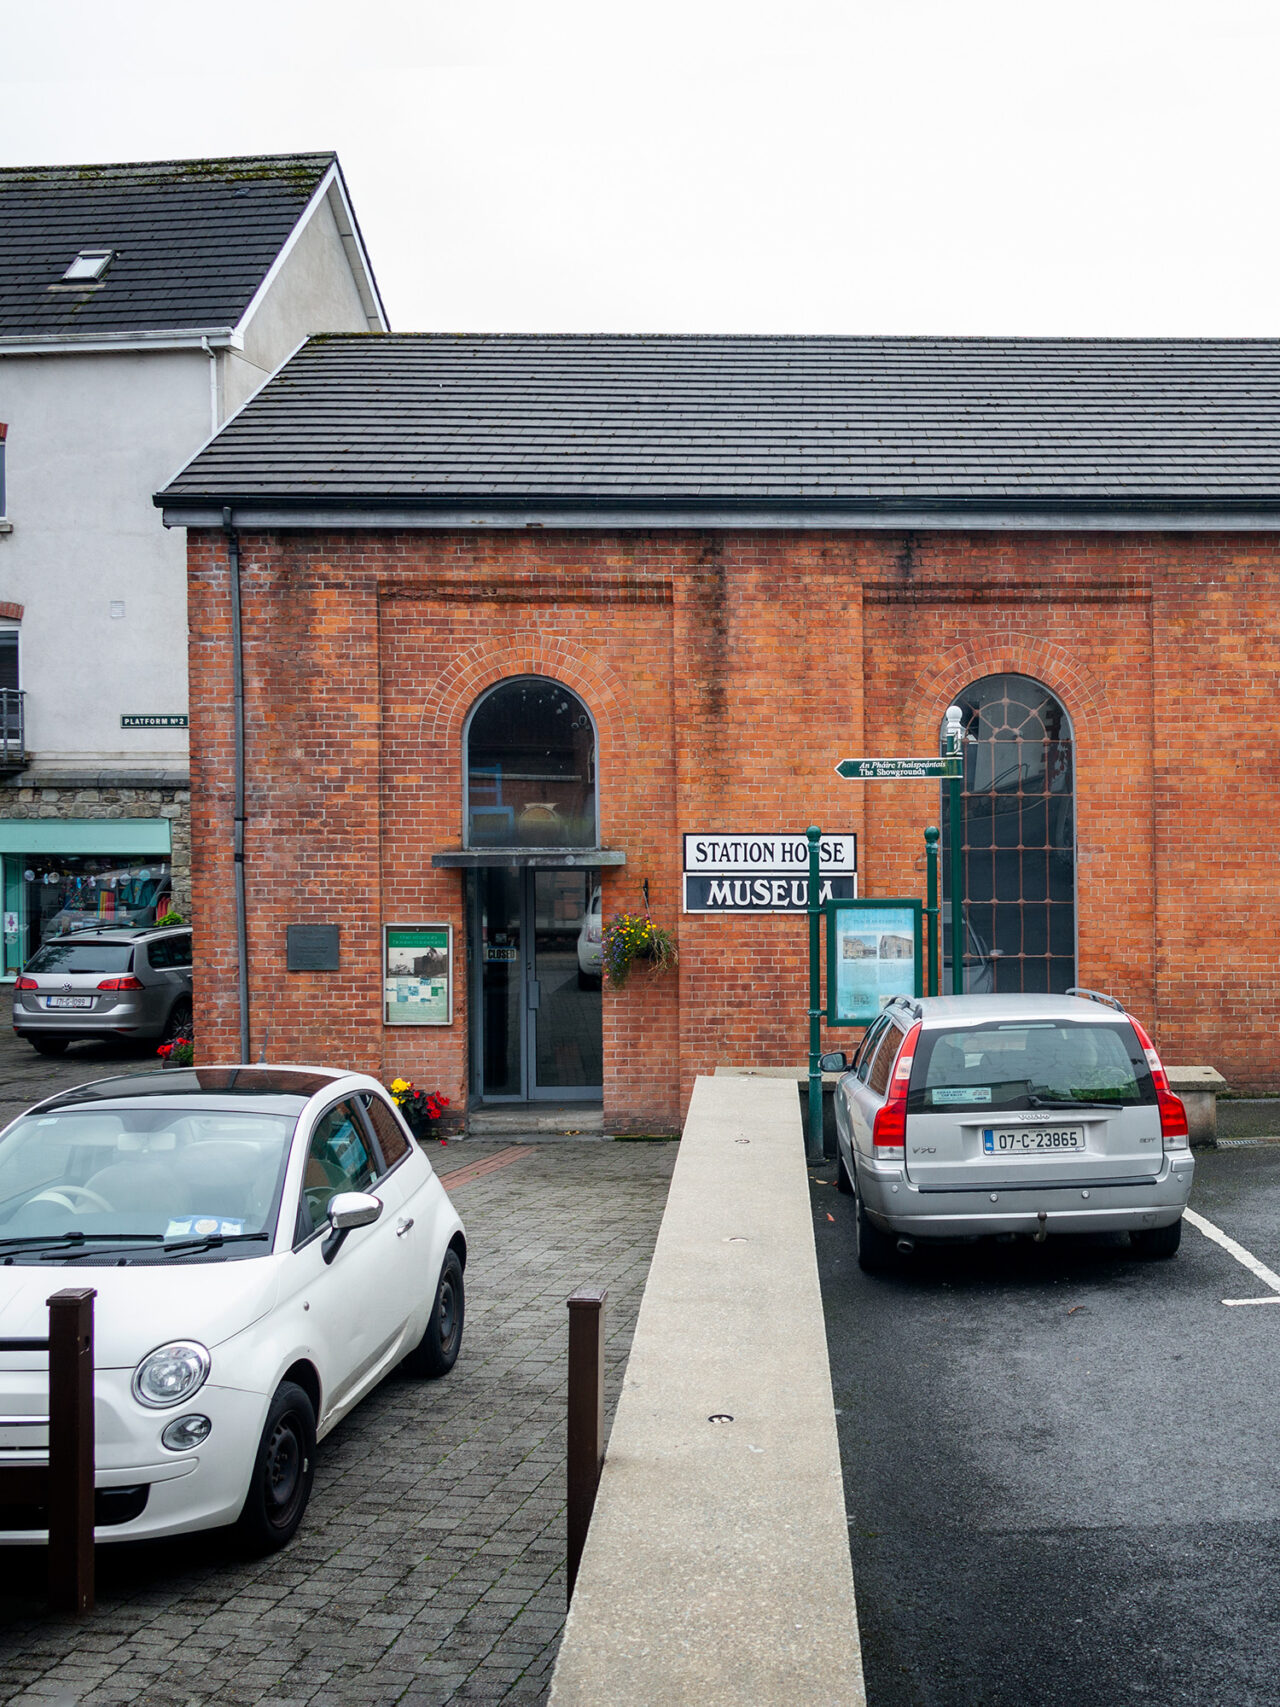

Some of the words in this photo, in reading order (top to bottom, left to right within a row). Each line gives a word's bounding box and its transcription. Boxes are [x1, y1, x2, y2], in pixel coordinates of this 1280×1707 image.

[859, 761, 870, 769] An
[860, 768, 874, 776] The
[876, 768, 926, 778] Showgrounds
[695, 842, 775, 863] STATION
[781, 842, 845, 863] HOSE
[487, 949, 515, 959] CLOSED
[999, 1132, 1077, 1149] 07-C-23865
[912, 1146, 937, 1154] V70
